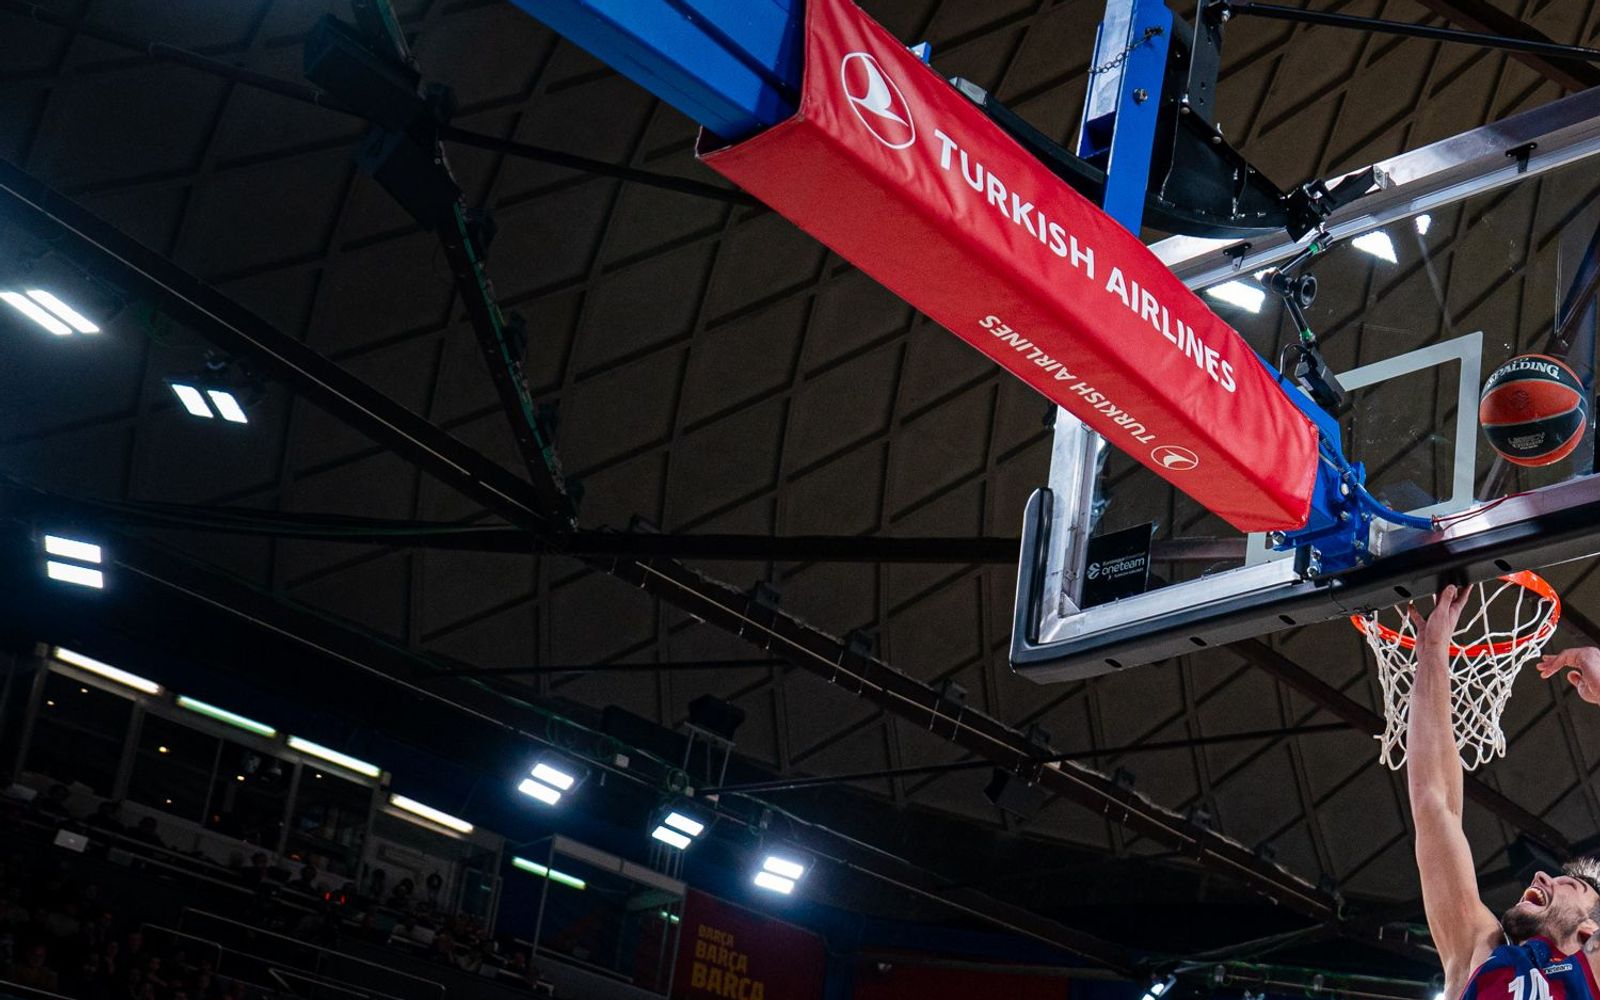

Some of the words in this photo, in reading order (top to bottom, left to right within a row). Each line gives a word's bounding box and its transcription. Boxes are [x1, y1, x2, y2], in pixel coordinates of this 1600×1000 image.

[935, 128, 1095, 280] TURKISH
[1105, 267, 1237, 394] AIRLINES
[978, 314, 1068, 383] AIRLINES
[1070, 373, 1156, 443] TURKISH
[1101, 557, 1145, 576] oneteam
